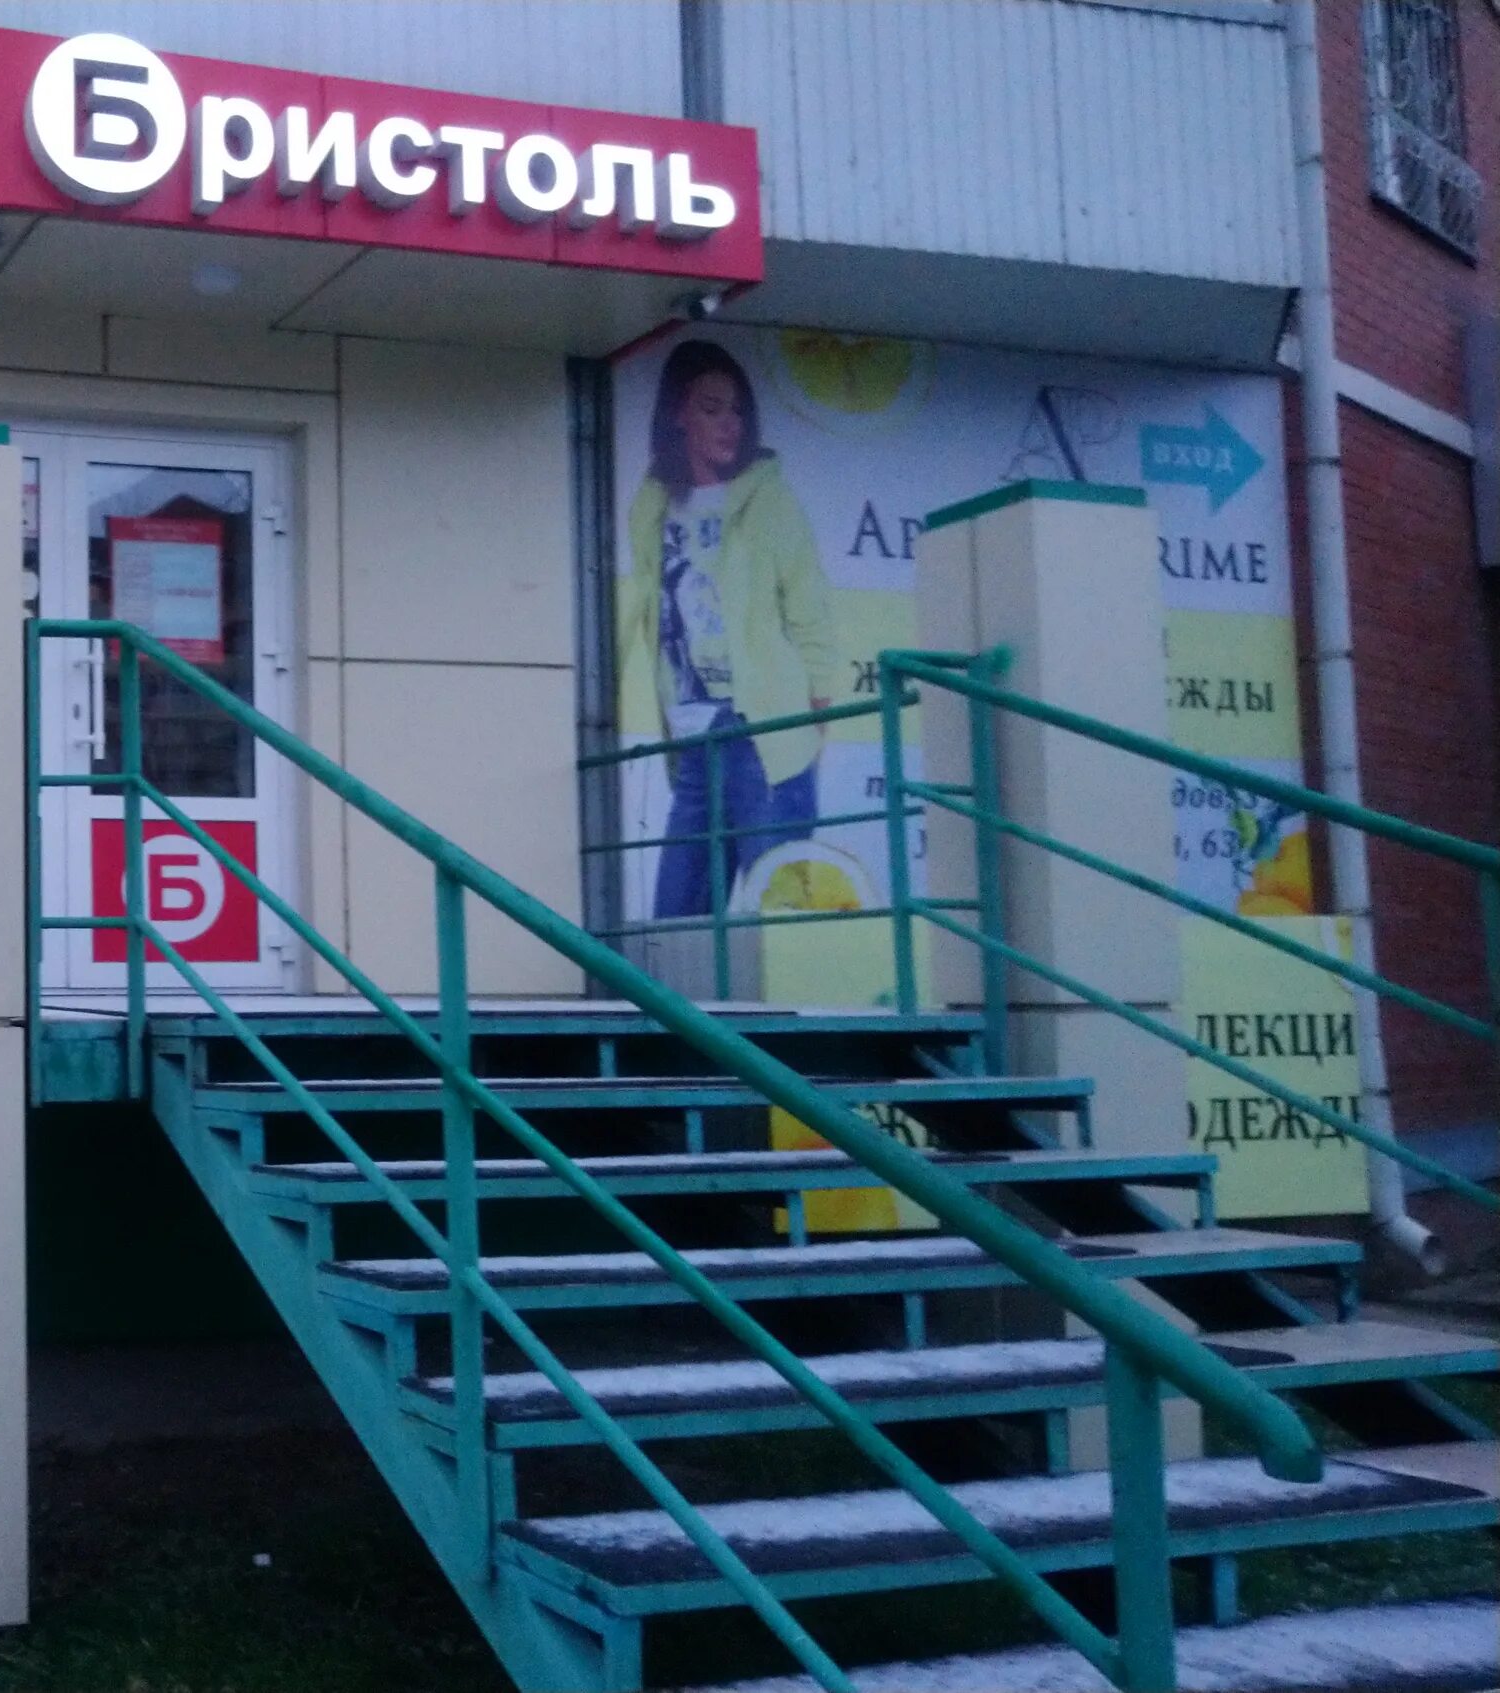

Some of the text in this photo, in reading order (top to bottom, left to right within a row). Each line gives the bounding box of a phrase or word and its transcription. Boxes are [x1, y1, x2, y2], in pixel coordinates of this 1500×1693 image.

[34, 38, 738, 230] Бристоль
[1156, 535, 1269, 583] RIME
[148, 854, 206, 922] Б
[1187, 1013, 1356, 1067] ЛЕКЦИ
